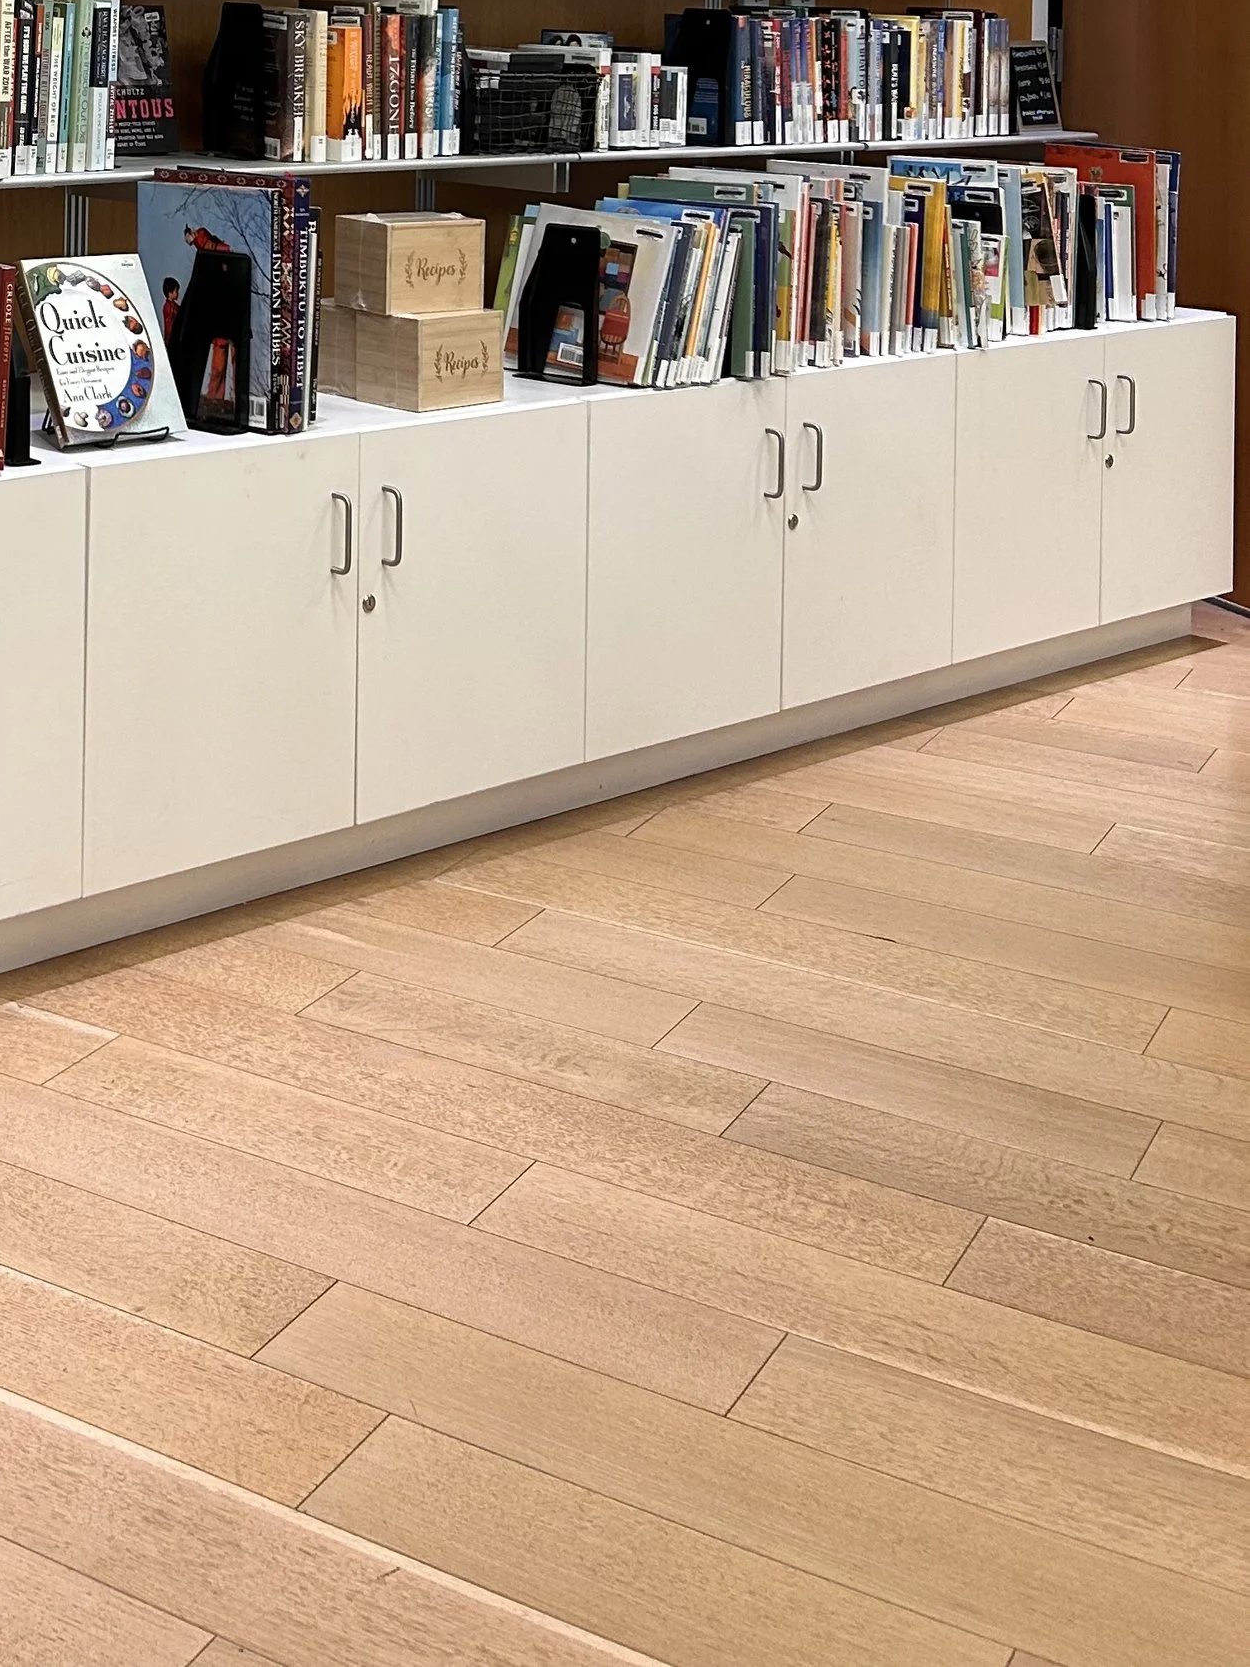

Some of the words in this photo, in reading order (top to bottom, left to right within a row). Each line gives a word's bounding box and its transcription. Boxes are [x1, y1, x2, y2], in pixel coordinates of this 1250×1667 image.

[294, 20, 306, 47] SKY
[2, 75, 10, 95] ZONE
[272, 254, 281, 308] INDIAN
[298, 227, 308, 311] TIMBUKTU
[415, 257, 456, 285] Recipes
[5, 284, 13, 323] CREOLE
[40, 299, 107, 335] Quick
[272, 313, 281, 366] TRIBES
[298, 316, 307, 339] TO
[3, 327, 12, 363] flavors
[49, 335, 127, 366] Cuisine
[296, 343, 306, 389] TIBET
[443, 351, 479, 379] Recipes
[63, 389, 84, 403] Ann
[84, 384, 113, 401] Clark
